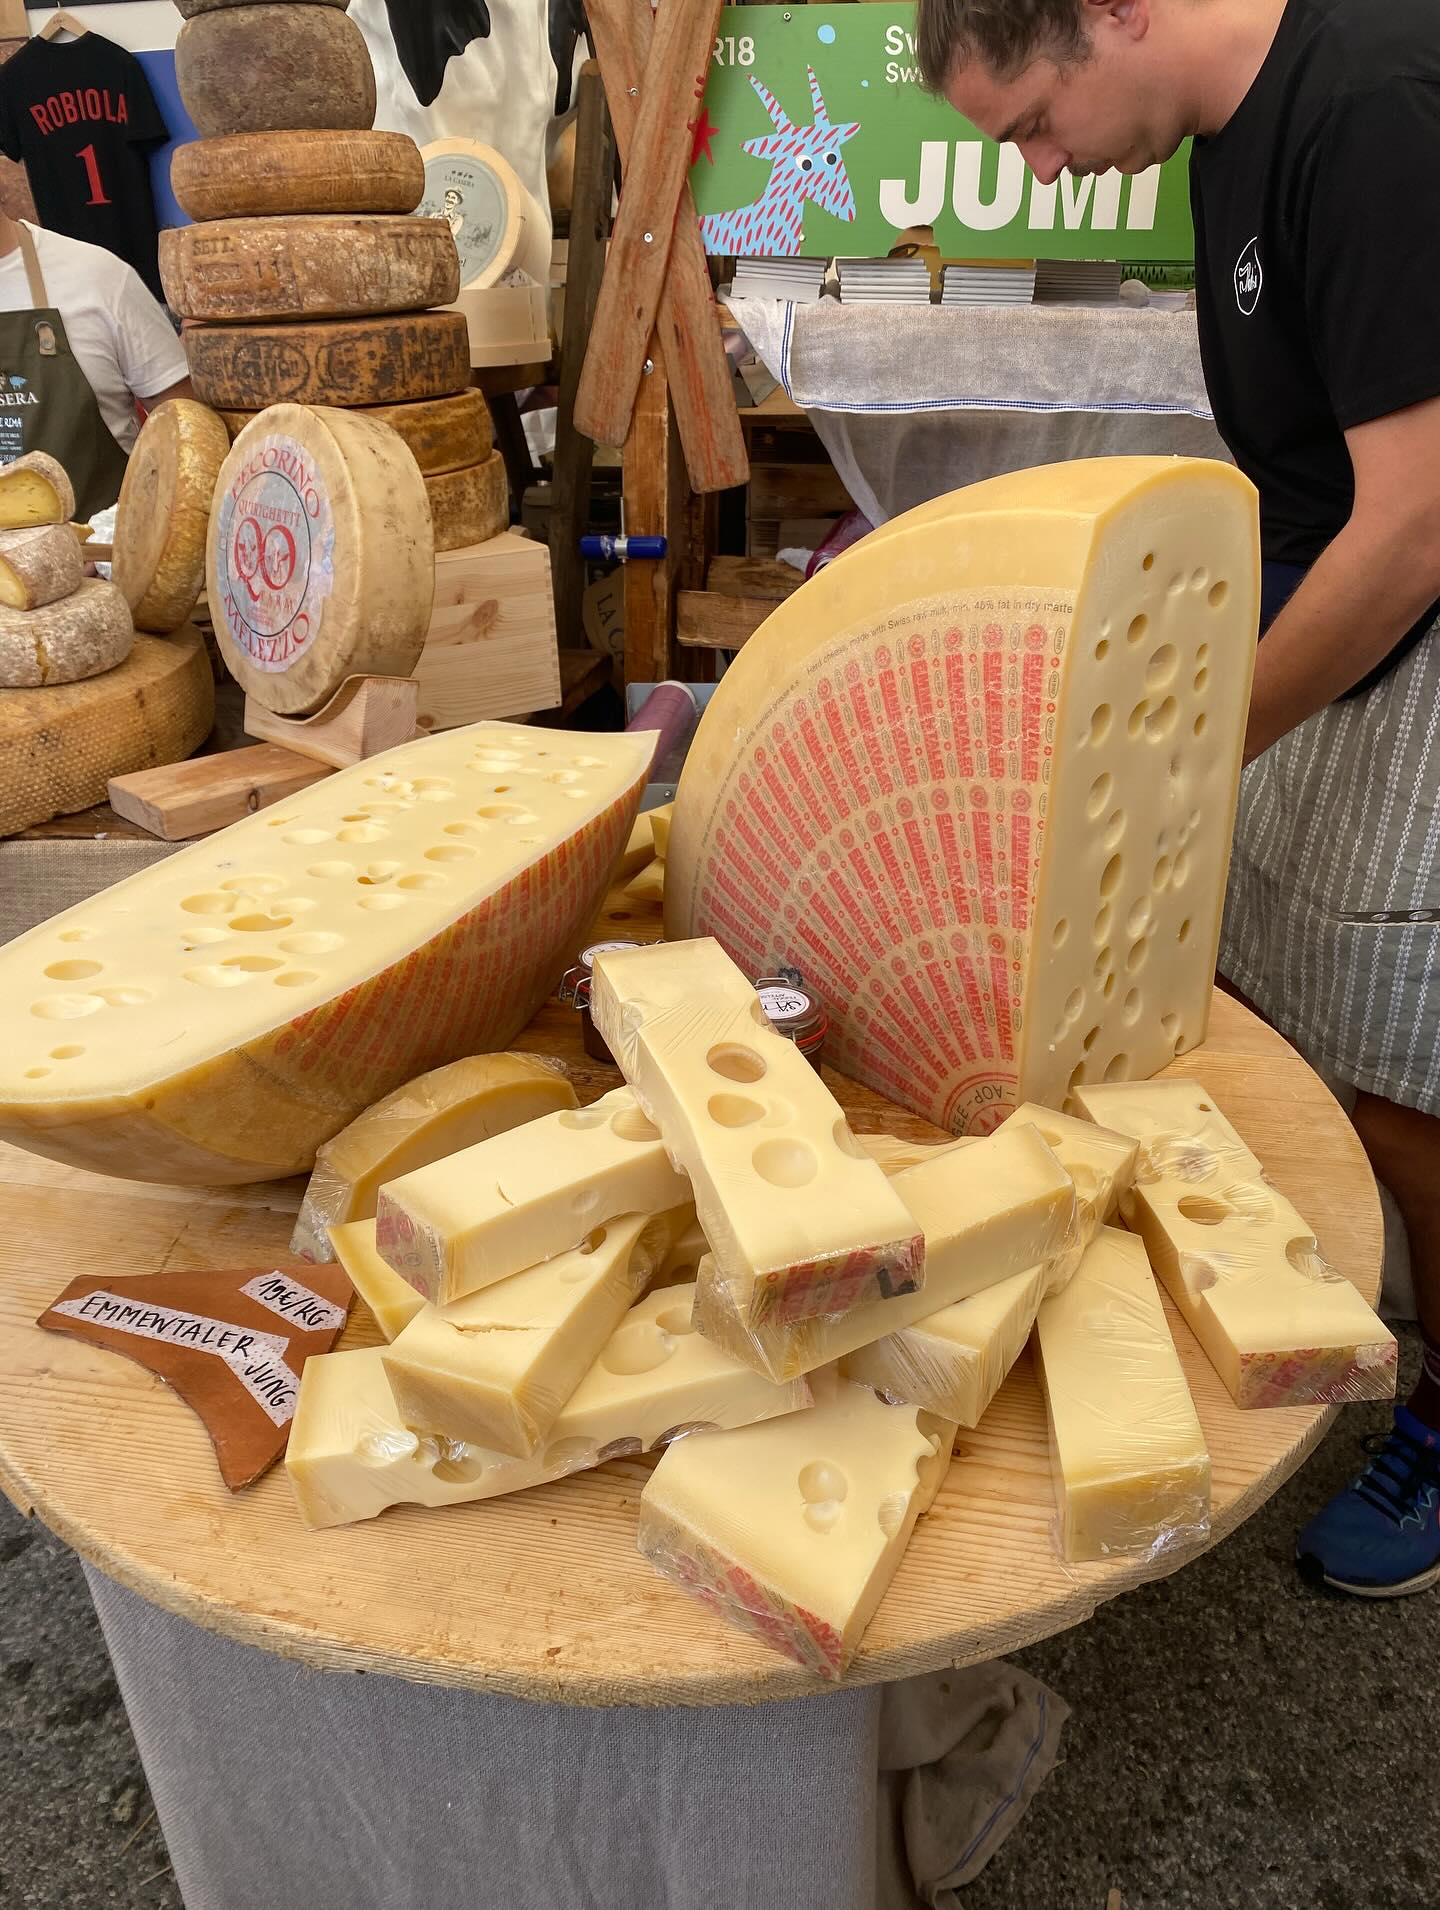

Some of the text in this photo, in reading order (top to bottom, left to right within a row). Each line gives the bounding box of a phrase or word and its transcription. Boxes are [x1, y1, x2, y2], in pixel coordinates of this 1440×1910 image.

[29, 88, 129, 136] ROBIOLA
[75, 143, 113, 206] 1
[879, 140, 1162, 231] JUMI
[231, 447, 320, 519] PECORINO
[887, 615, 911, 630] Swiss
[974, 1084, 1003, 1104] AOP
[79, 1295, 255, 1358] EMMENTALER
[245, 1361, 297, 1408] JUNG
